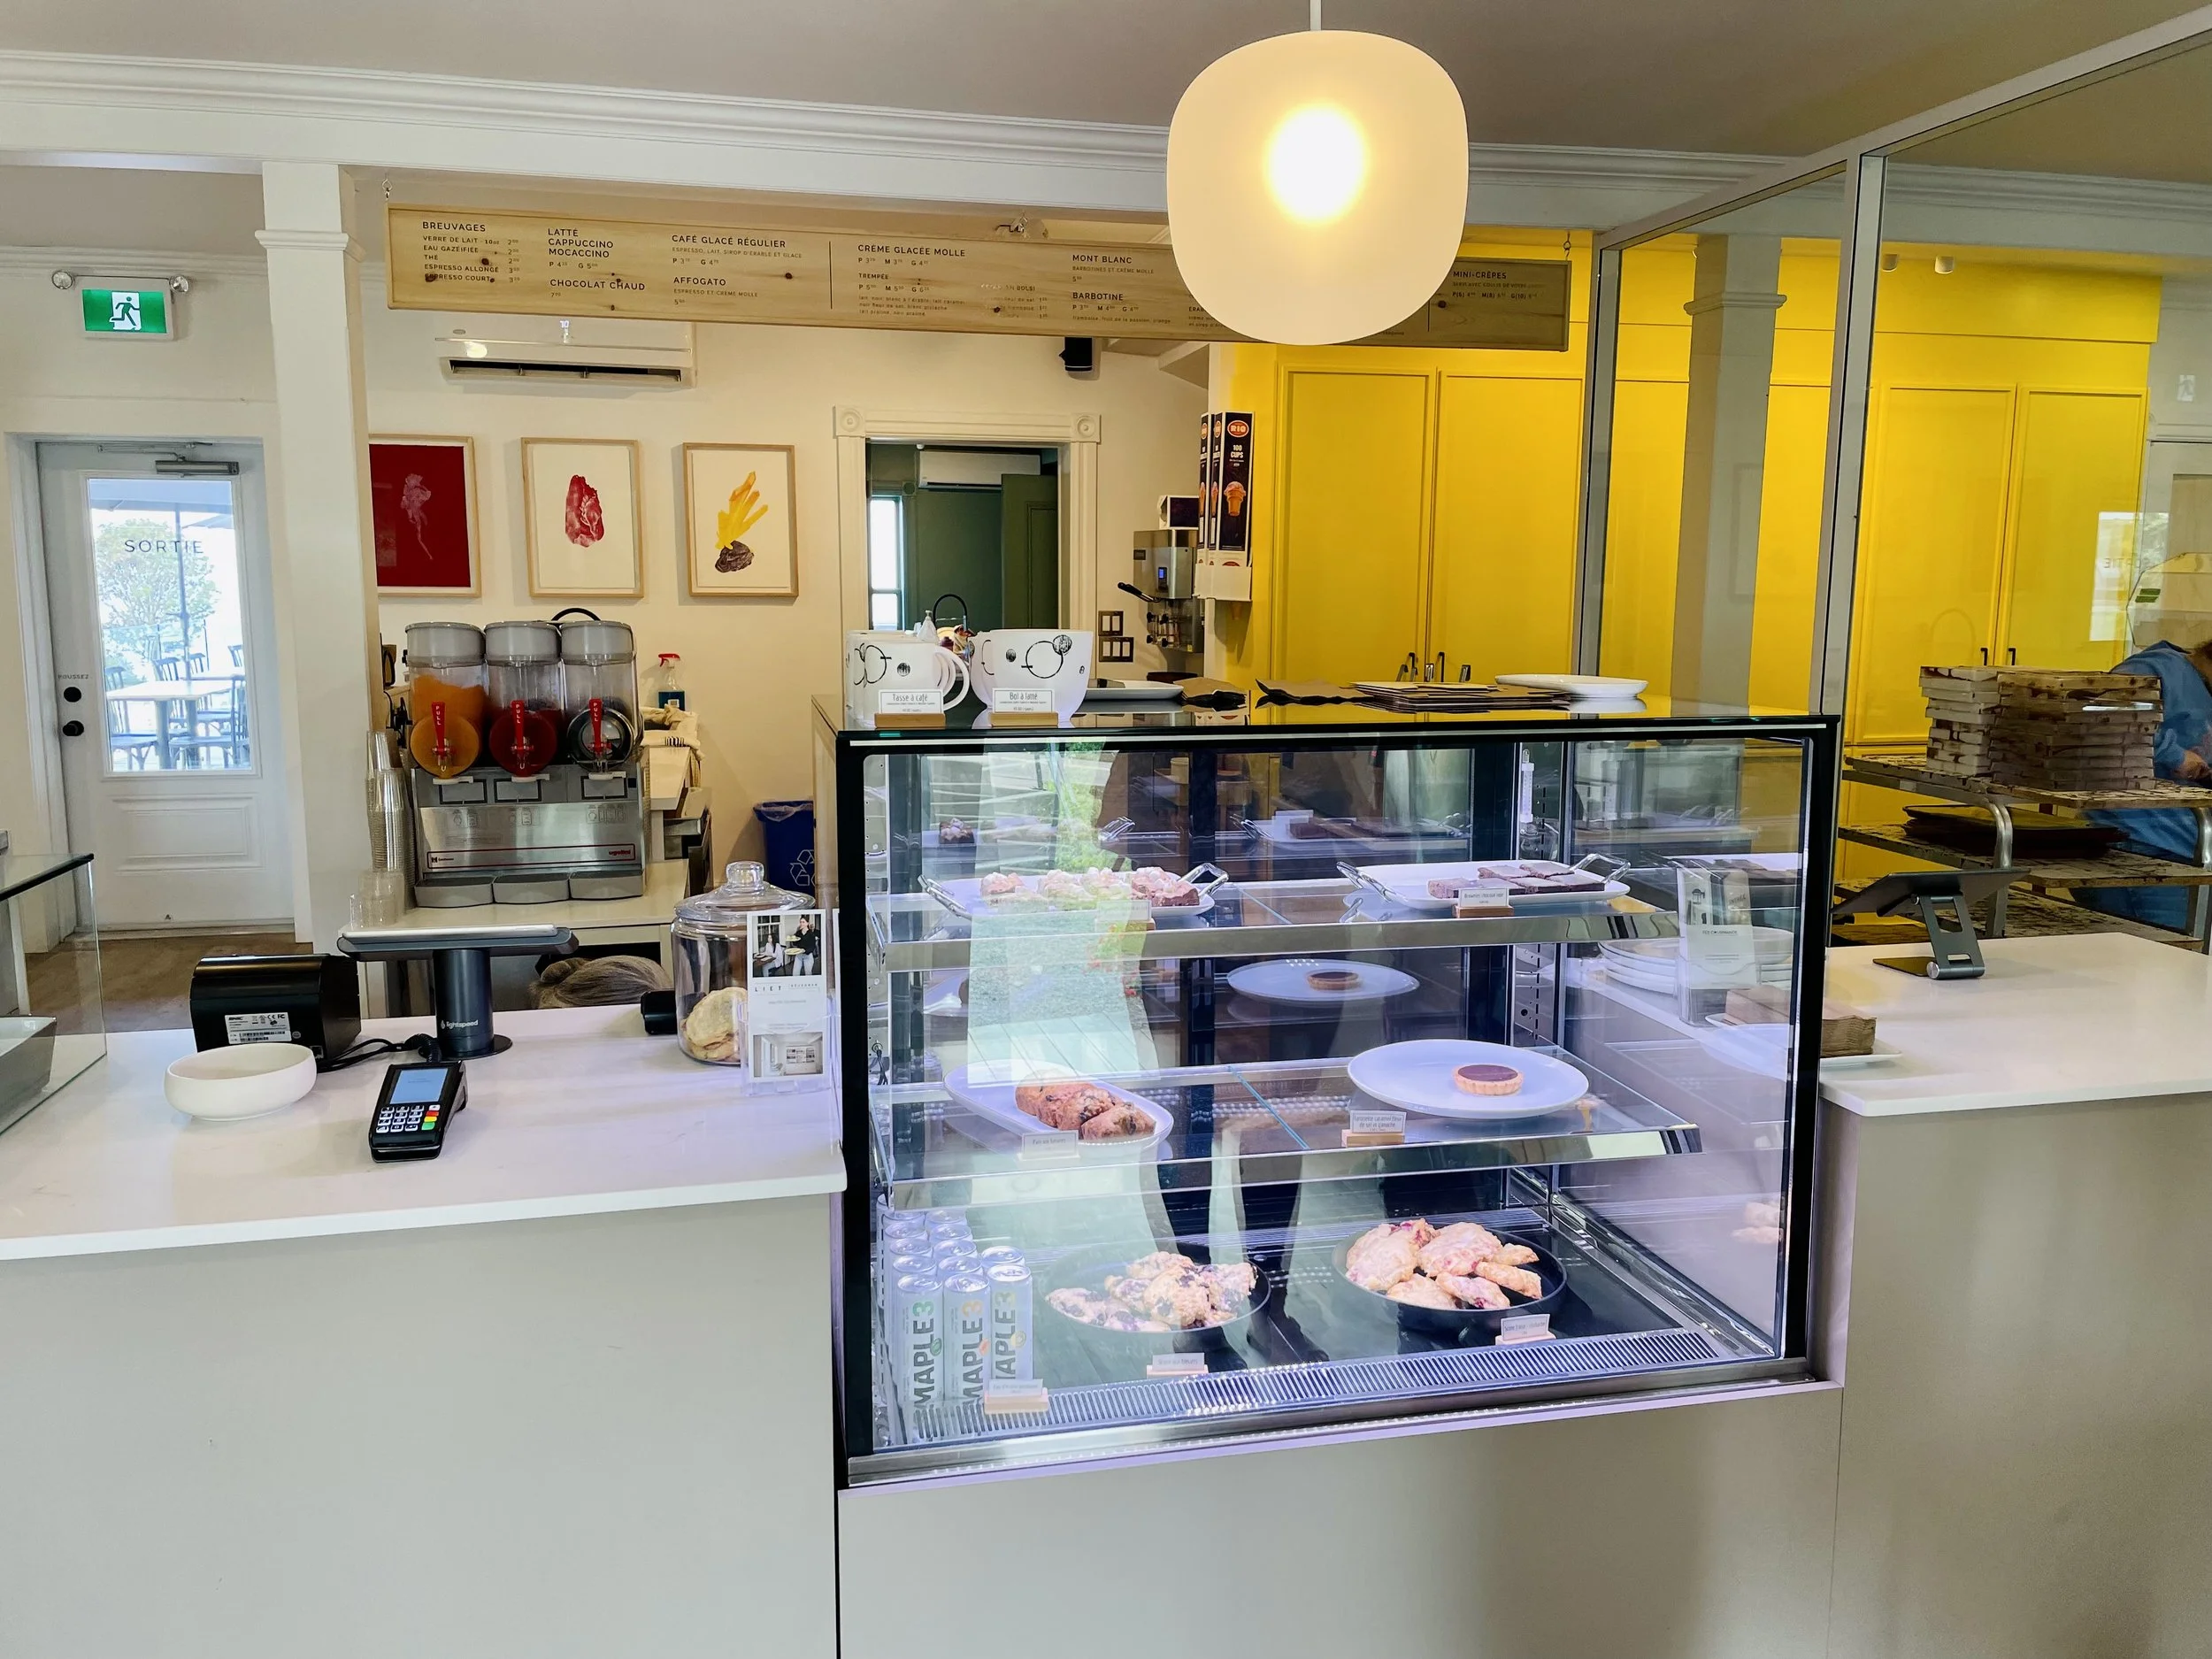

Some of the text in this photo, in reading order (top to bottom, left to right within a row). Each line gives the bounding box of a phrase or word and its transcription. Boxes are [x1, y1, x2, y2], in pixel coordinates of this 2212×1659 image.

[422, 221, 486, 232] BREUVAGES
[548, 238, 614, 249] CAPPUCCINO
[672, 234, 786, 248] CAFÉ GLACÉ RÉGULIER
[549, 248, 610, 258] MOCACCINO
[933, 248, 965, 257] MOLLE
[549, 279, 645, 290] CHOCOLAT CHAUD
[673, 276, 726, 286] AFFOGATO
[1072, 291, 1124, 301] BARBOTINE
[124, 540, 204, 554] SORTIE
[892, 693, 910, 702] Tasse
[915, 693, 928, 703] café
[1010, 692, 1019, 701] Bol
[446, 1019, 479, 1029] lightspeed
